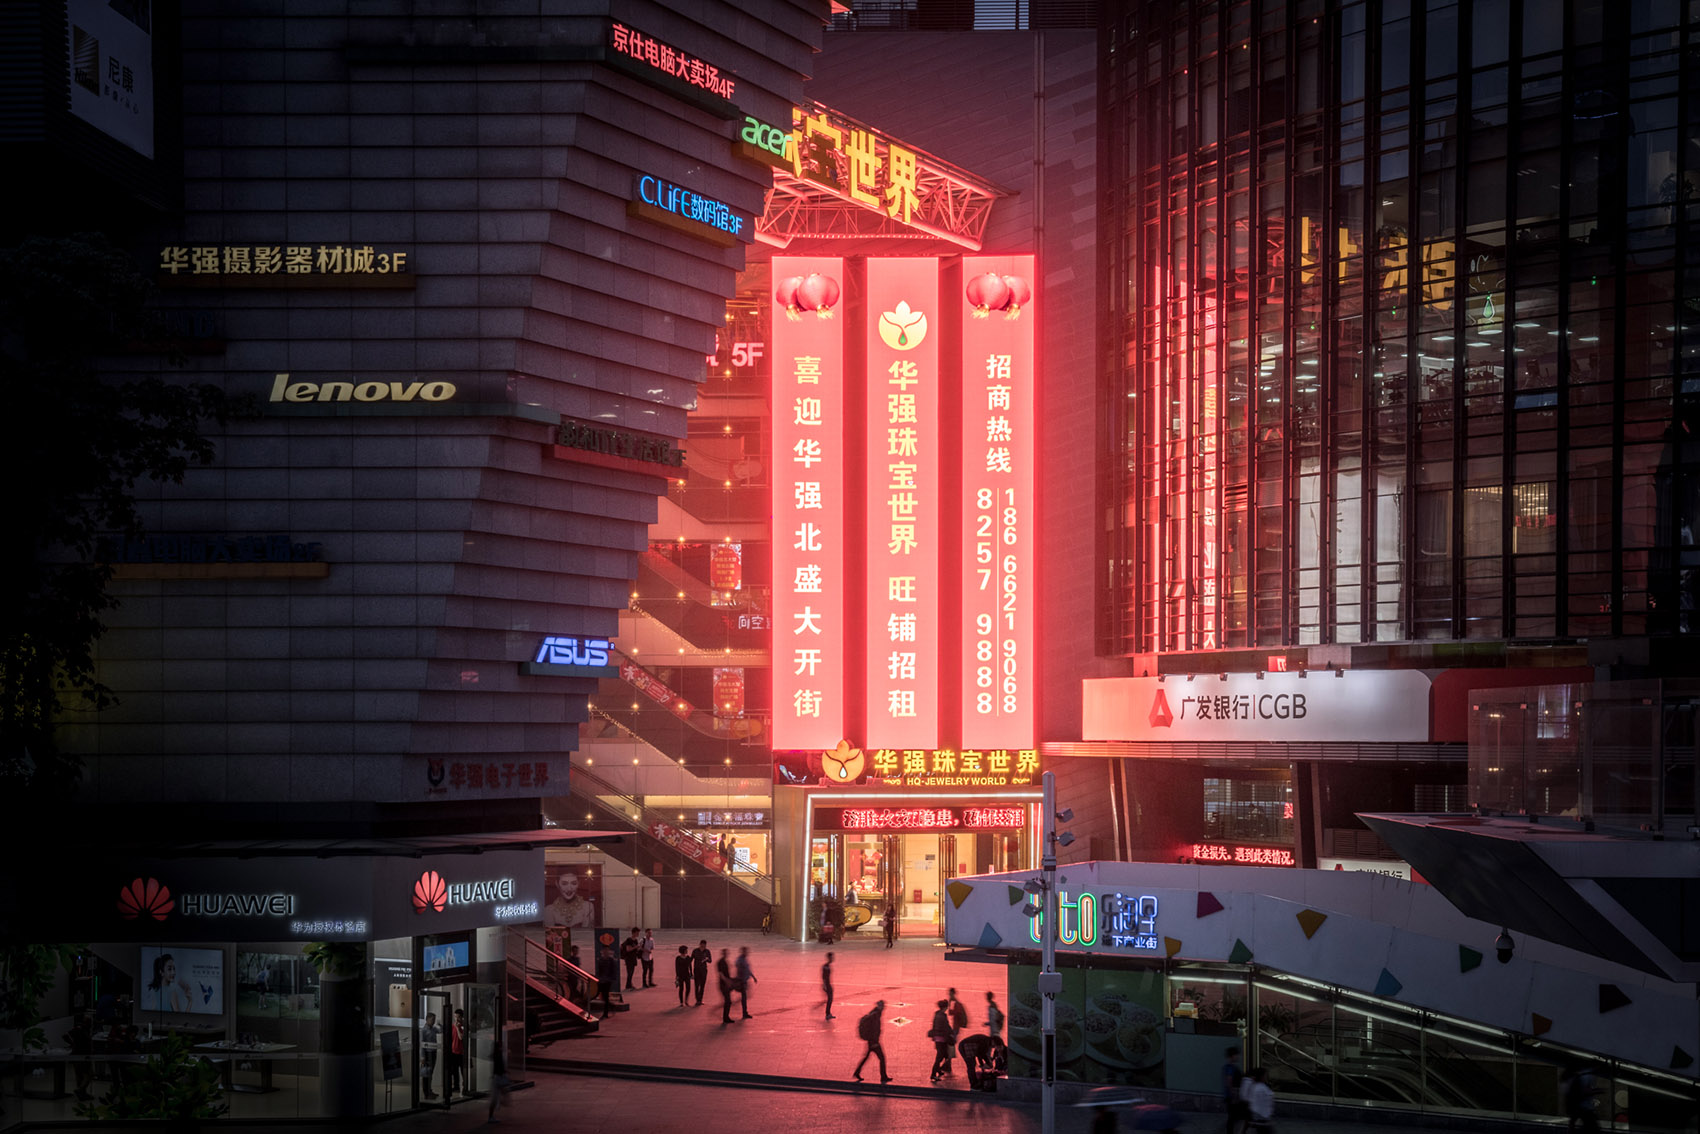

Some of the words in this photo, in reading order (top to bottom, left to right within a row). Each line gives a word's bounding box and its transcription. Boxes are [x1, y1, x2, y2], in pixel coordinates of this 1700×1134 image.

[108, 56, 134, 93] 尼康
[611, 23, 735, 100] 京仕电脑大卖场4F
[741, 116, 792, 158] acer
[160, 246, 407, 275] 华强摄影器材城3F
[731, 342, 764, 367] 5F
[269, 373, 457, 402] lenovo
[986, 354, 1012, 473] 招商热线
[887, 360, 918, 555] 华强珠宝世界
[793, 355, 822, 718] 喜迎华强北盛大开街
[976, 488, 992, 591] 8257
[536, 636, 609, 667] ASUS
[887, 576, 917, 718] 旺铺招租
[976, 613, 992, 714] 9888
[1180, 695, 1250, 720] 广发银行
[1258, 693, 1307, 719] CGB
[449, 762, 549, 789] 华强电子世界
[874, 749, 1040, 773] 华强珠宝世界
[907, 777, 969, 786] HQ-JEWELRY
[971, 777, 1006, 786] WORLD
[183, 893, 295, 916] HUAWEI
[448, 879, 515, 904] HUAWEI
